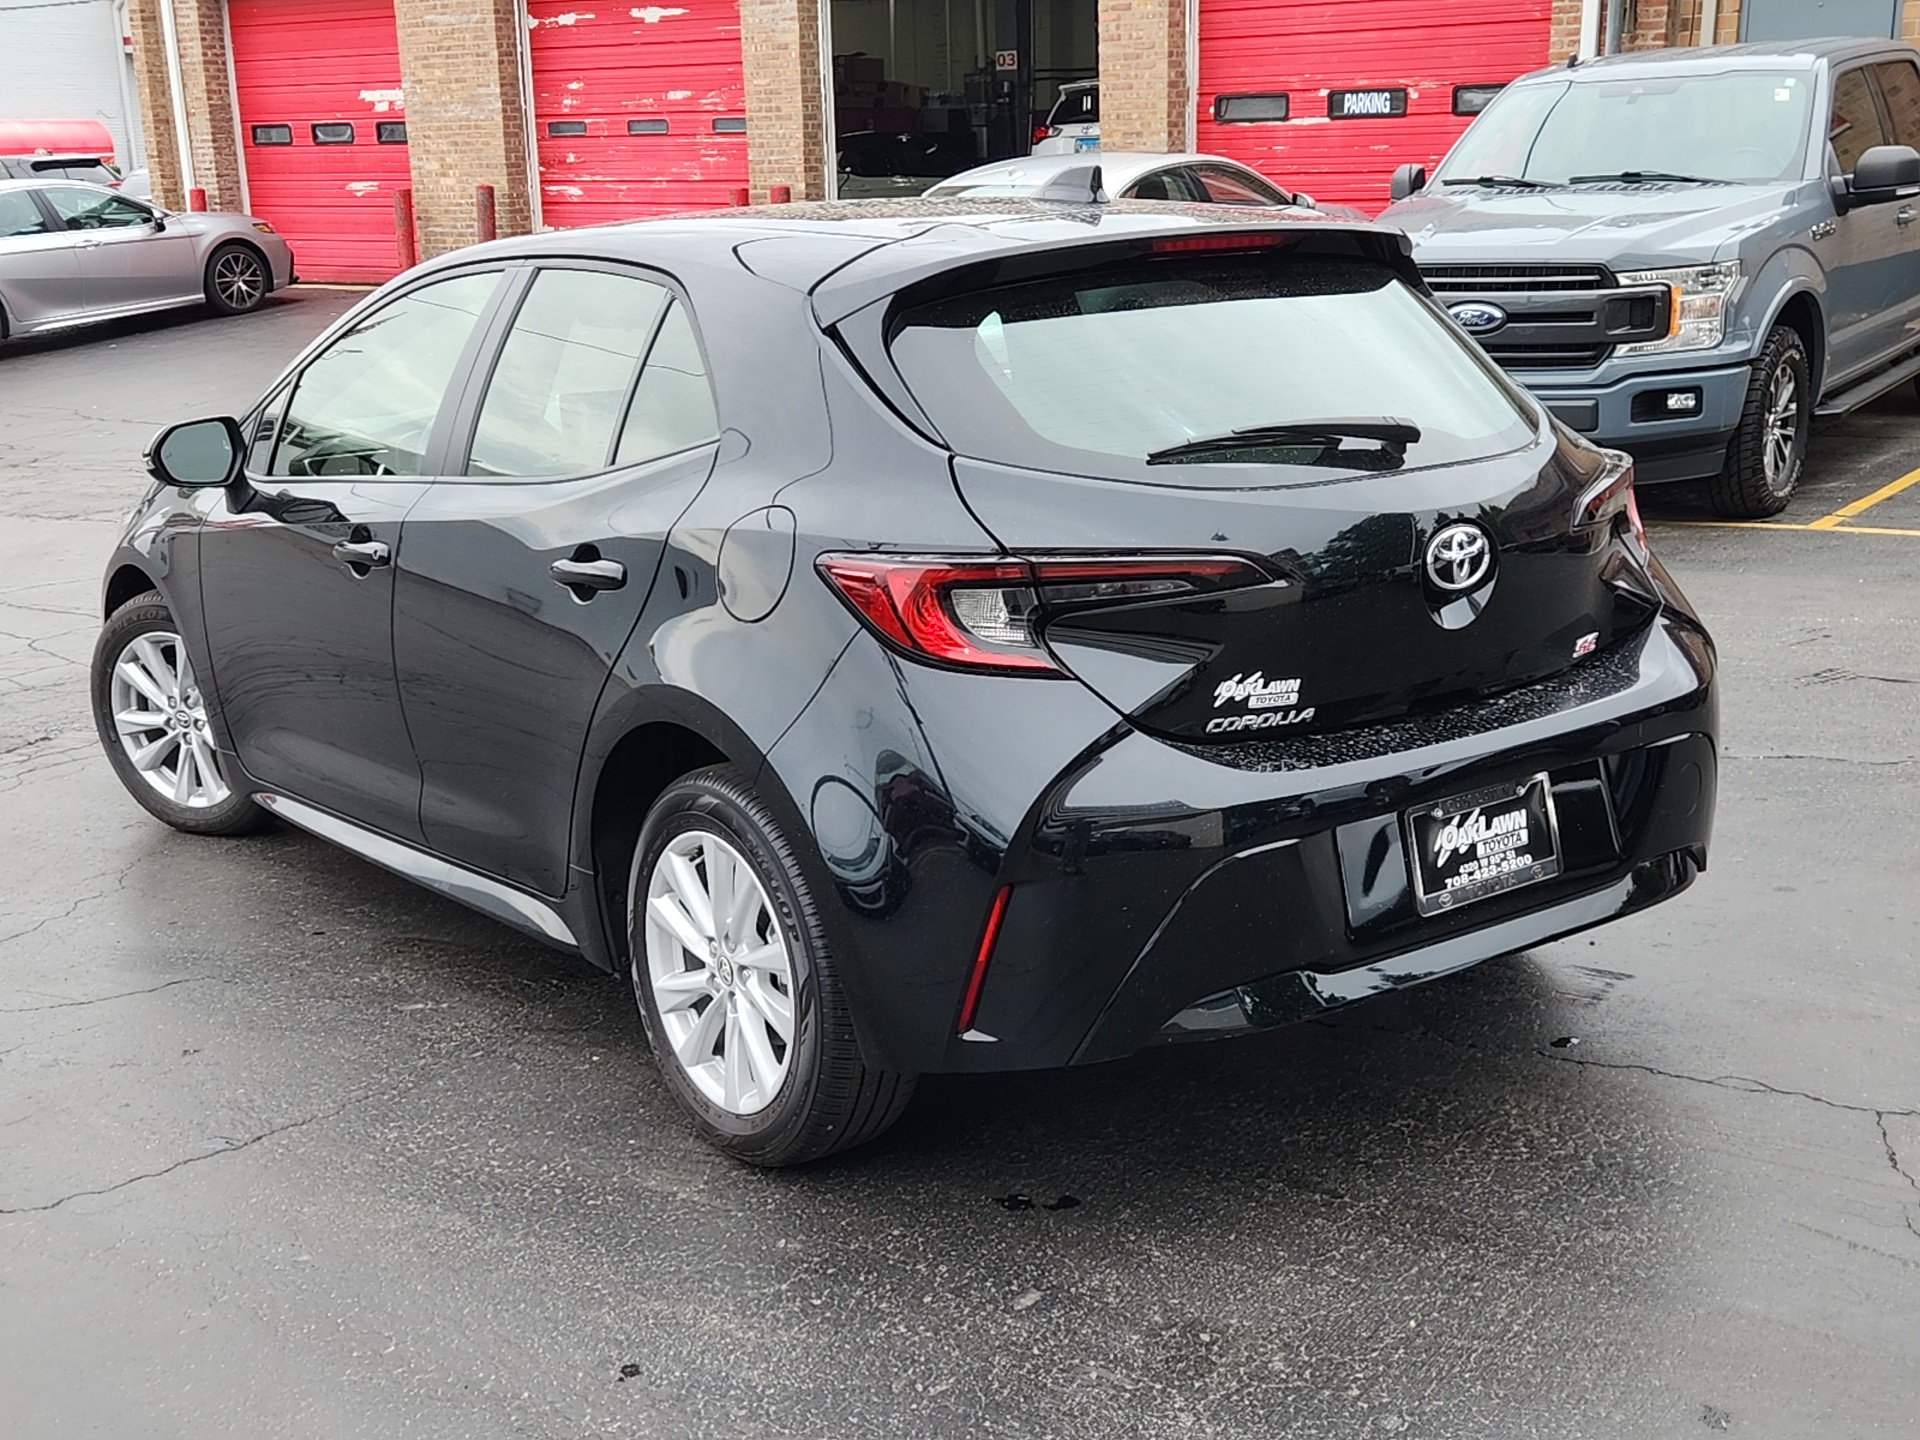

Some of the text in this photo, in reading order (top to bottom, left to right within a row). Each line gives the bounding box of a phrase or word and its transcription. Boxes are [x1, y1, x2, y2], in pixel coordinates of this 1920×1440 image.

[996, 53, 1015, 67] 03
[1343, 92, 1391, 114] PARKING
[1458, 310, 1489, 325] Ford
[1255, 694, 1291, 704] TOYOTA
[1206, 707, 1315, 733] COROLLA
[1482, 833, 1522, 852] TOYOTA
[1445, 854, 1533, 889] 708-423-5200
[1480, 858, 1489, 867] W
[1465, 873, 1518, 898] TOYOTA
